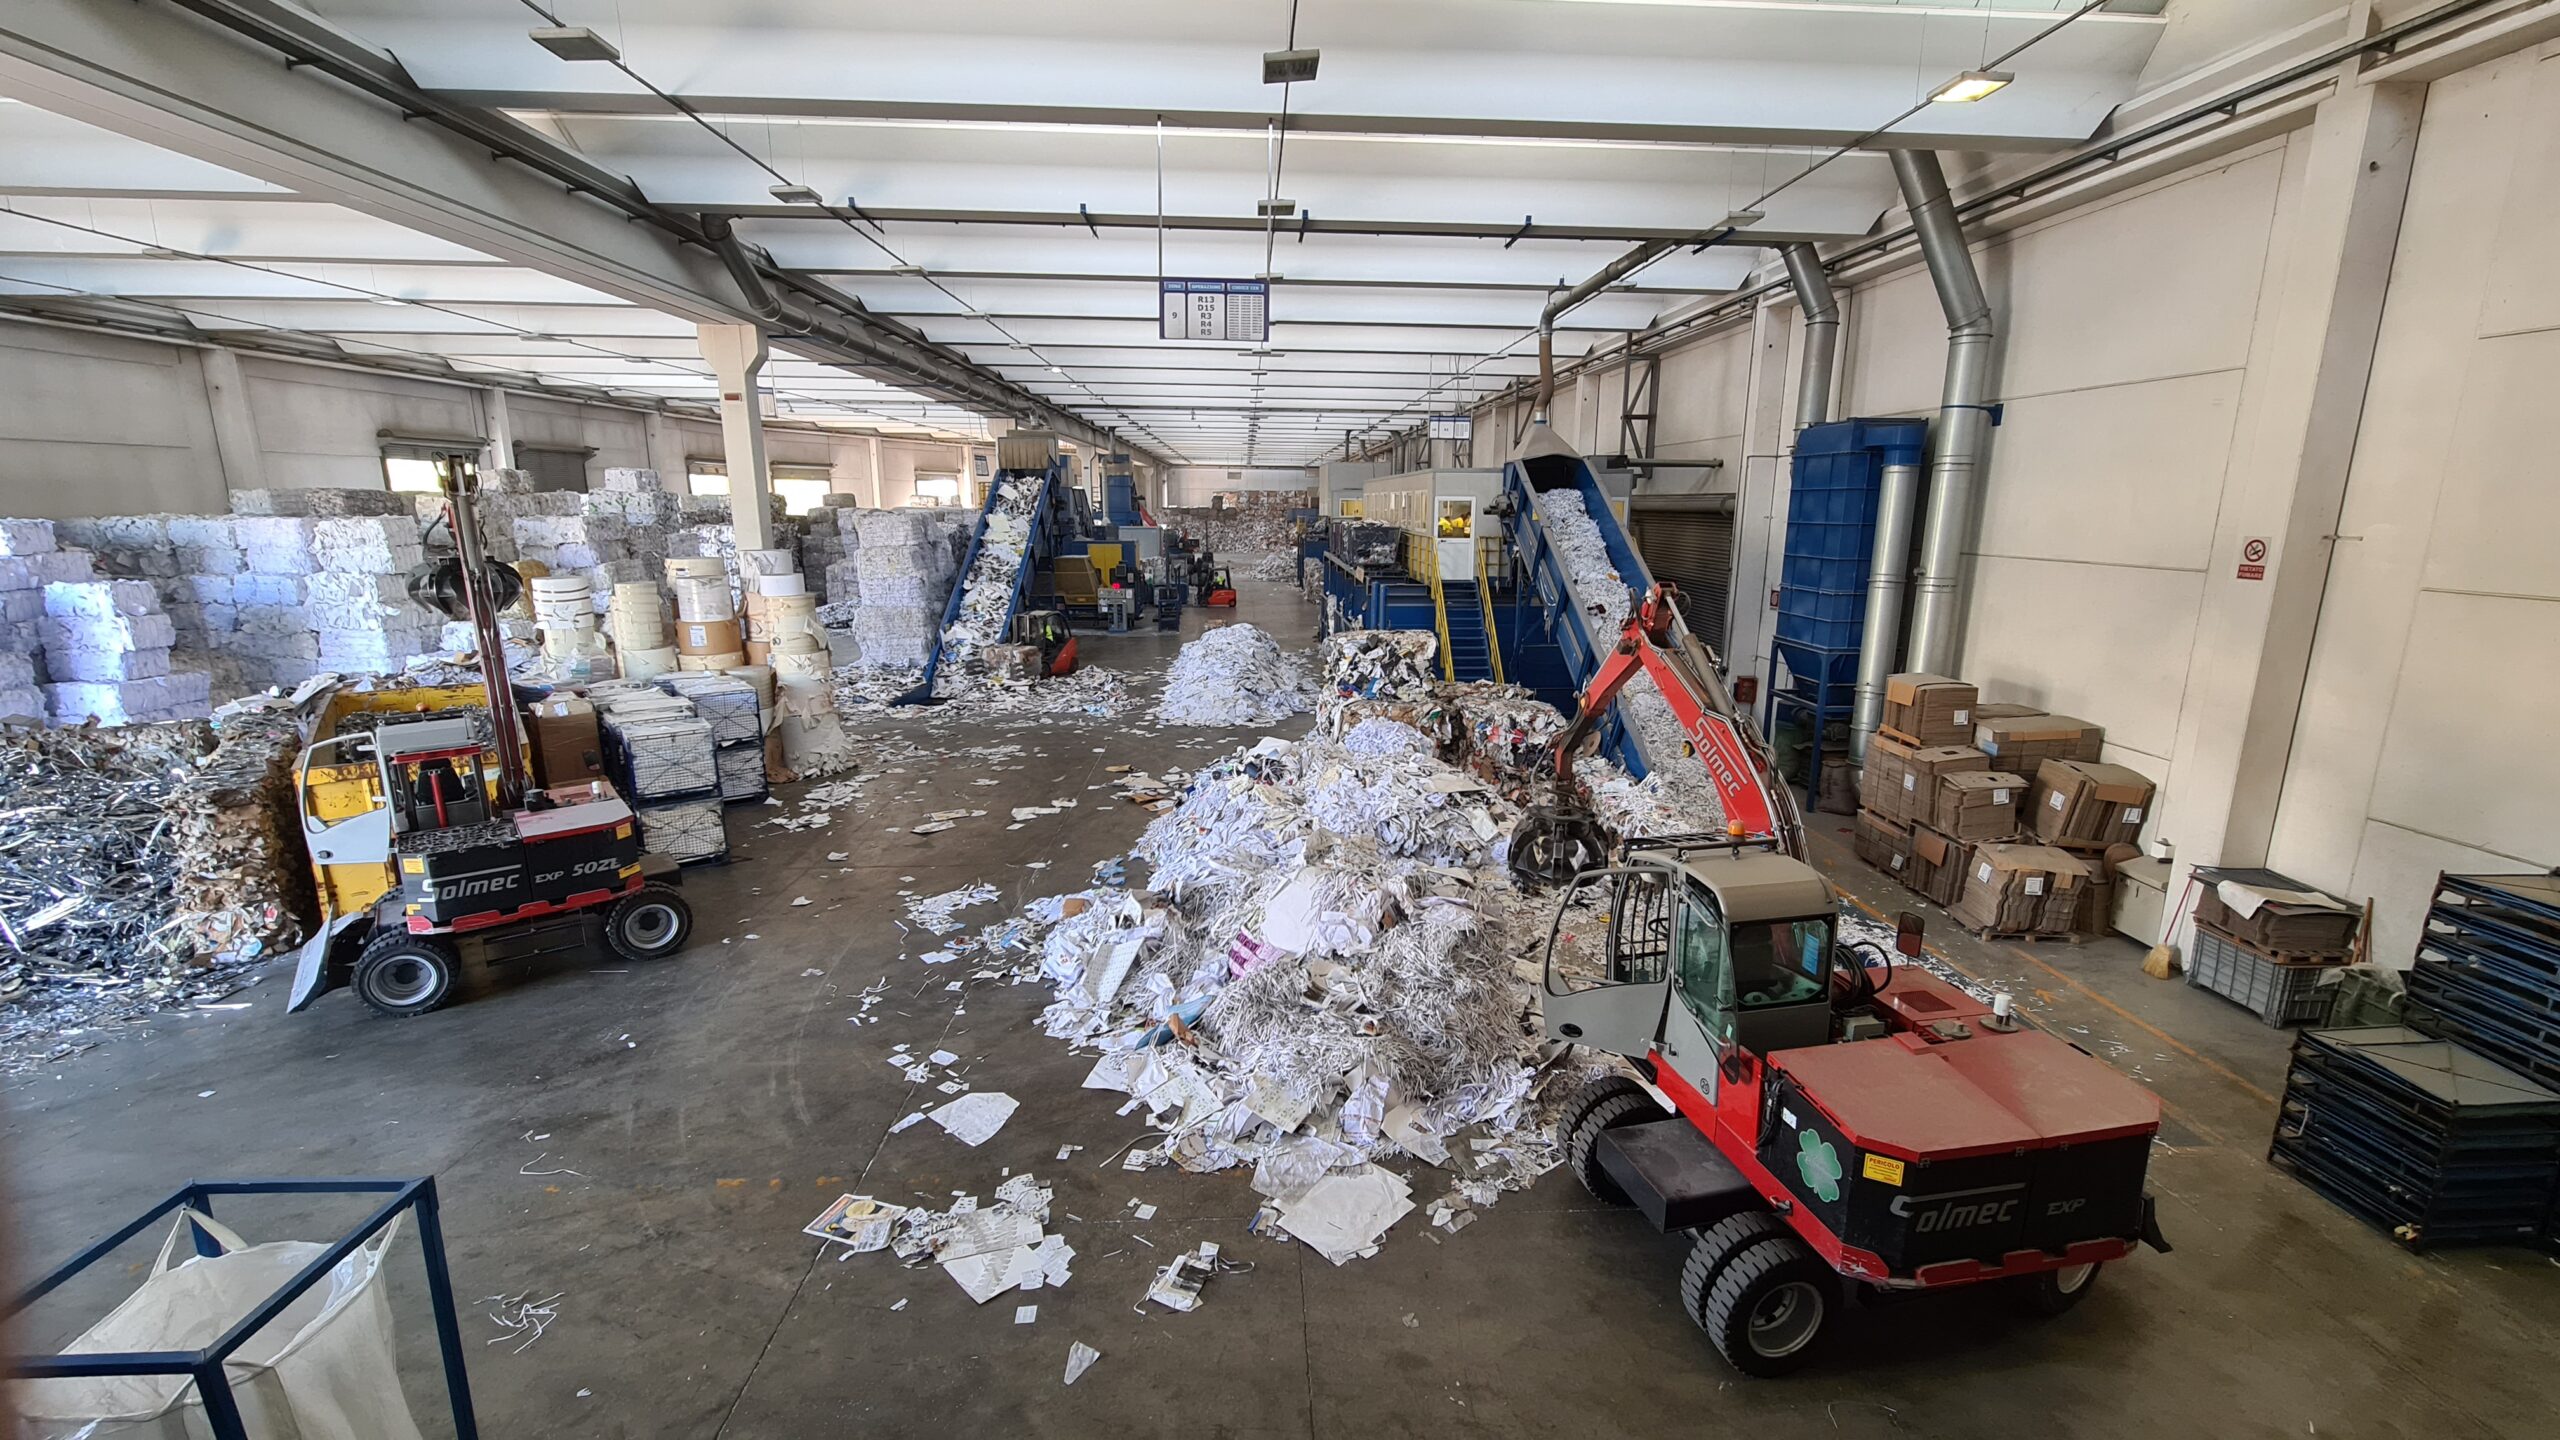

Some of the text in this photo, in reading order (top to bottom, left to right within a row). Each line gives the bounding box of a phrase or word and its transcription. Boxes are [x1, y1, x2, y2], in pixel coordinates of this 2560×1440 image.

[1687, 717, 1748, 798] Solmec
[418, 864, 521, 903] Solmec
[534, 870, 565, 884] EXP
[1869, 1157, 1900, 1170] PERICOLO
[2047, 1198, 2087, 1216] EXP
